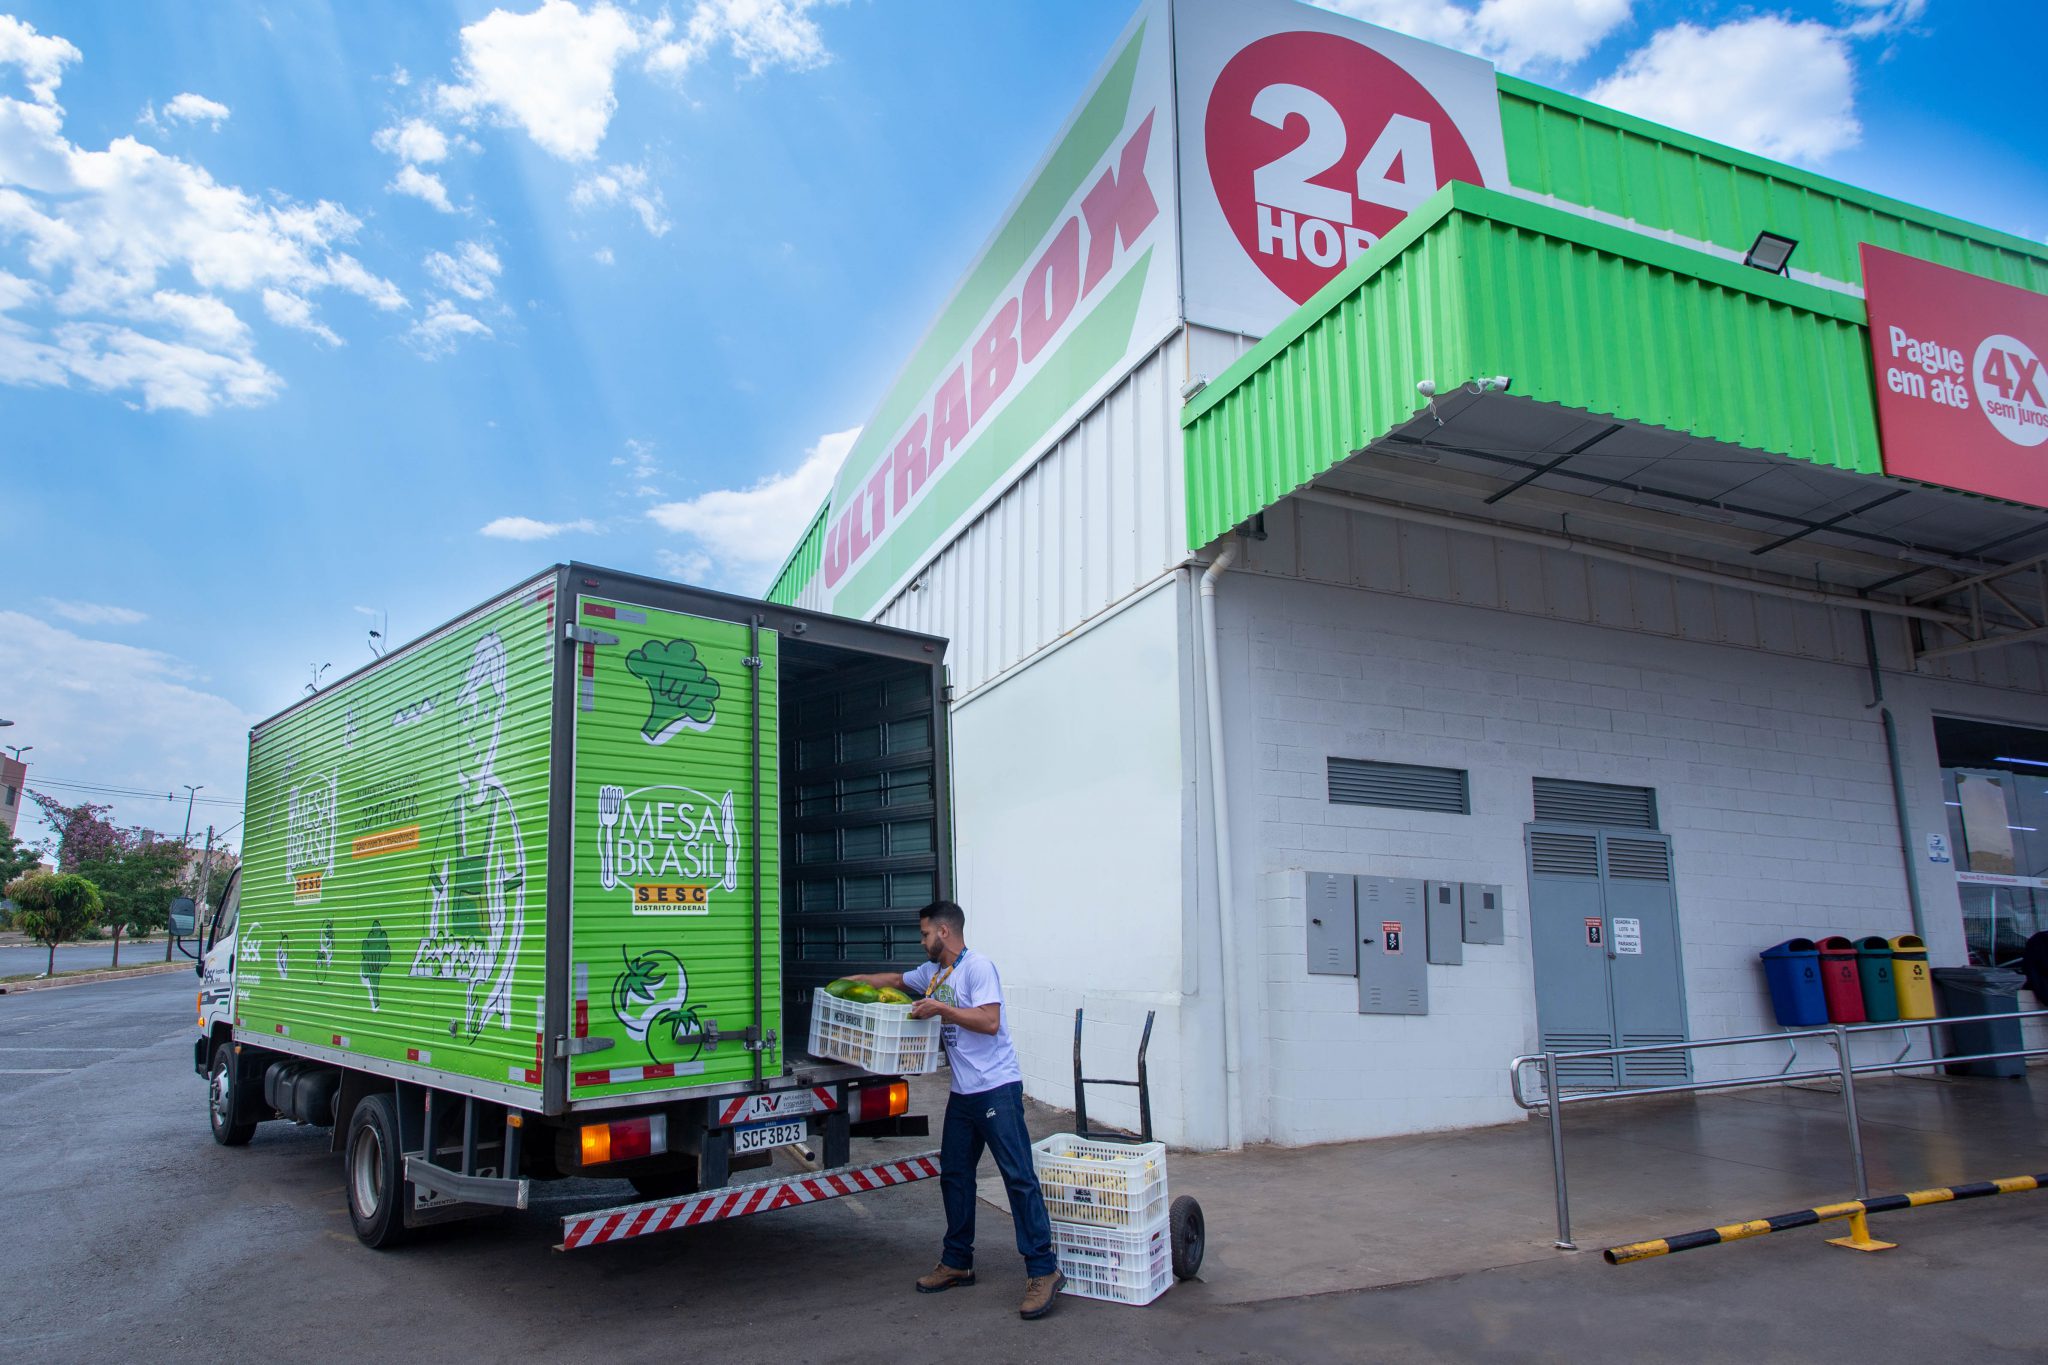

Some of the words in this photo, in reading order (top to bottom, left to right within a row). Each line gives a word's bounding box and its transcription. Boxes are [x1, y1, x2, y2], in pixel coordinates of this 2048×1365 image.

[1250, 83, 1438, 225] 24
[824, 105, 1160, 590] ULTRABOX
[1888, 325, 1965, 375] Pague
[1887, 367, 1926, 399] em
[1931, 376, 1970, 410] até
[1982, 347, 2048, 409] 4X
[1986, 400, 2016, 420] sem
[2017, 403, 2048, 428] juros
[620, 800, 722, 842] MESA
[617, 839, 722, 878] BRASIL
[296, 875, 321, 891] SESC
[638, 887, 704, 902] SESC
[834, 1012, 846, 1023] MESA
[846, 1013, 862, 1028] BRASIL
[752, 1095, 782, 1114] JRV
[742, 1124, 801, 1149] SCF3B23
[1075, 1188, 1092, 1197] MESA
[1068, 1247, 1083, 1256] MESA
[1085, 1249, 1107, 1259] BRASIL
